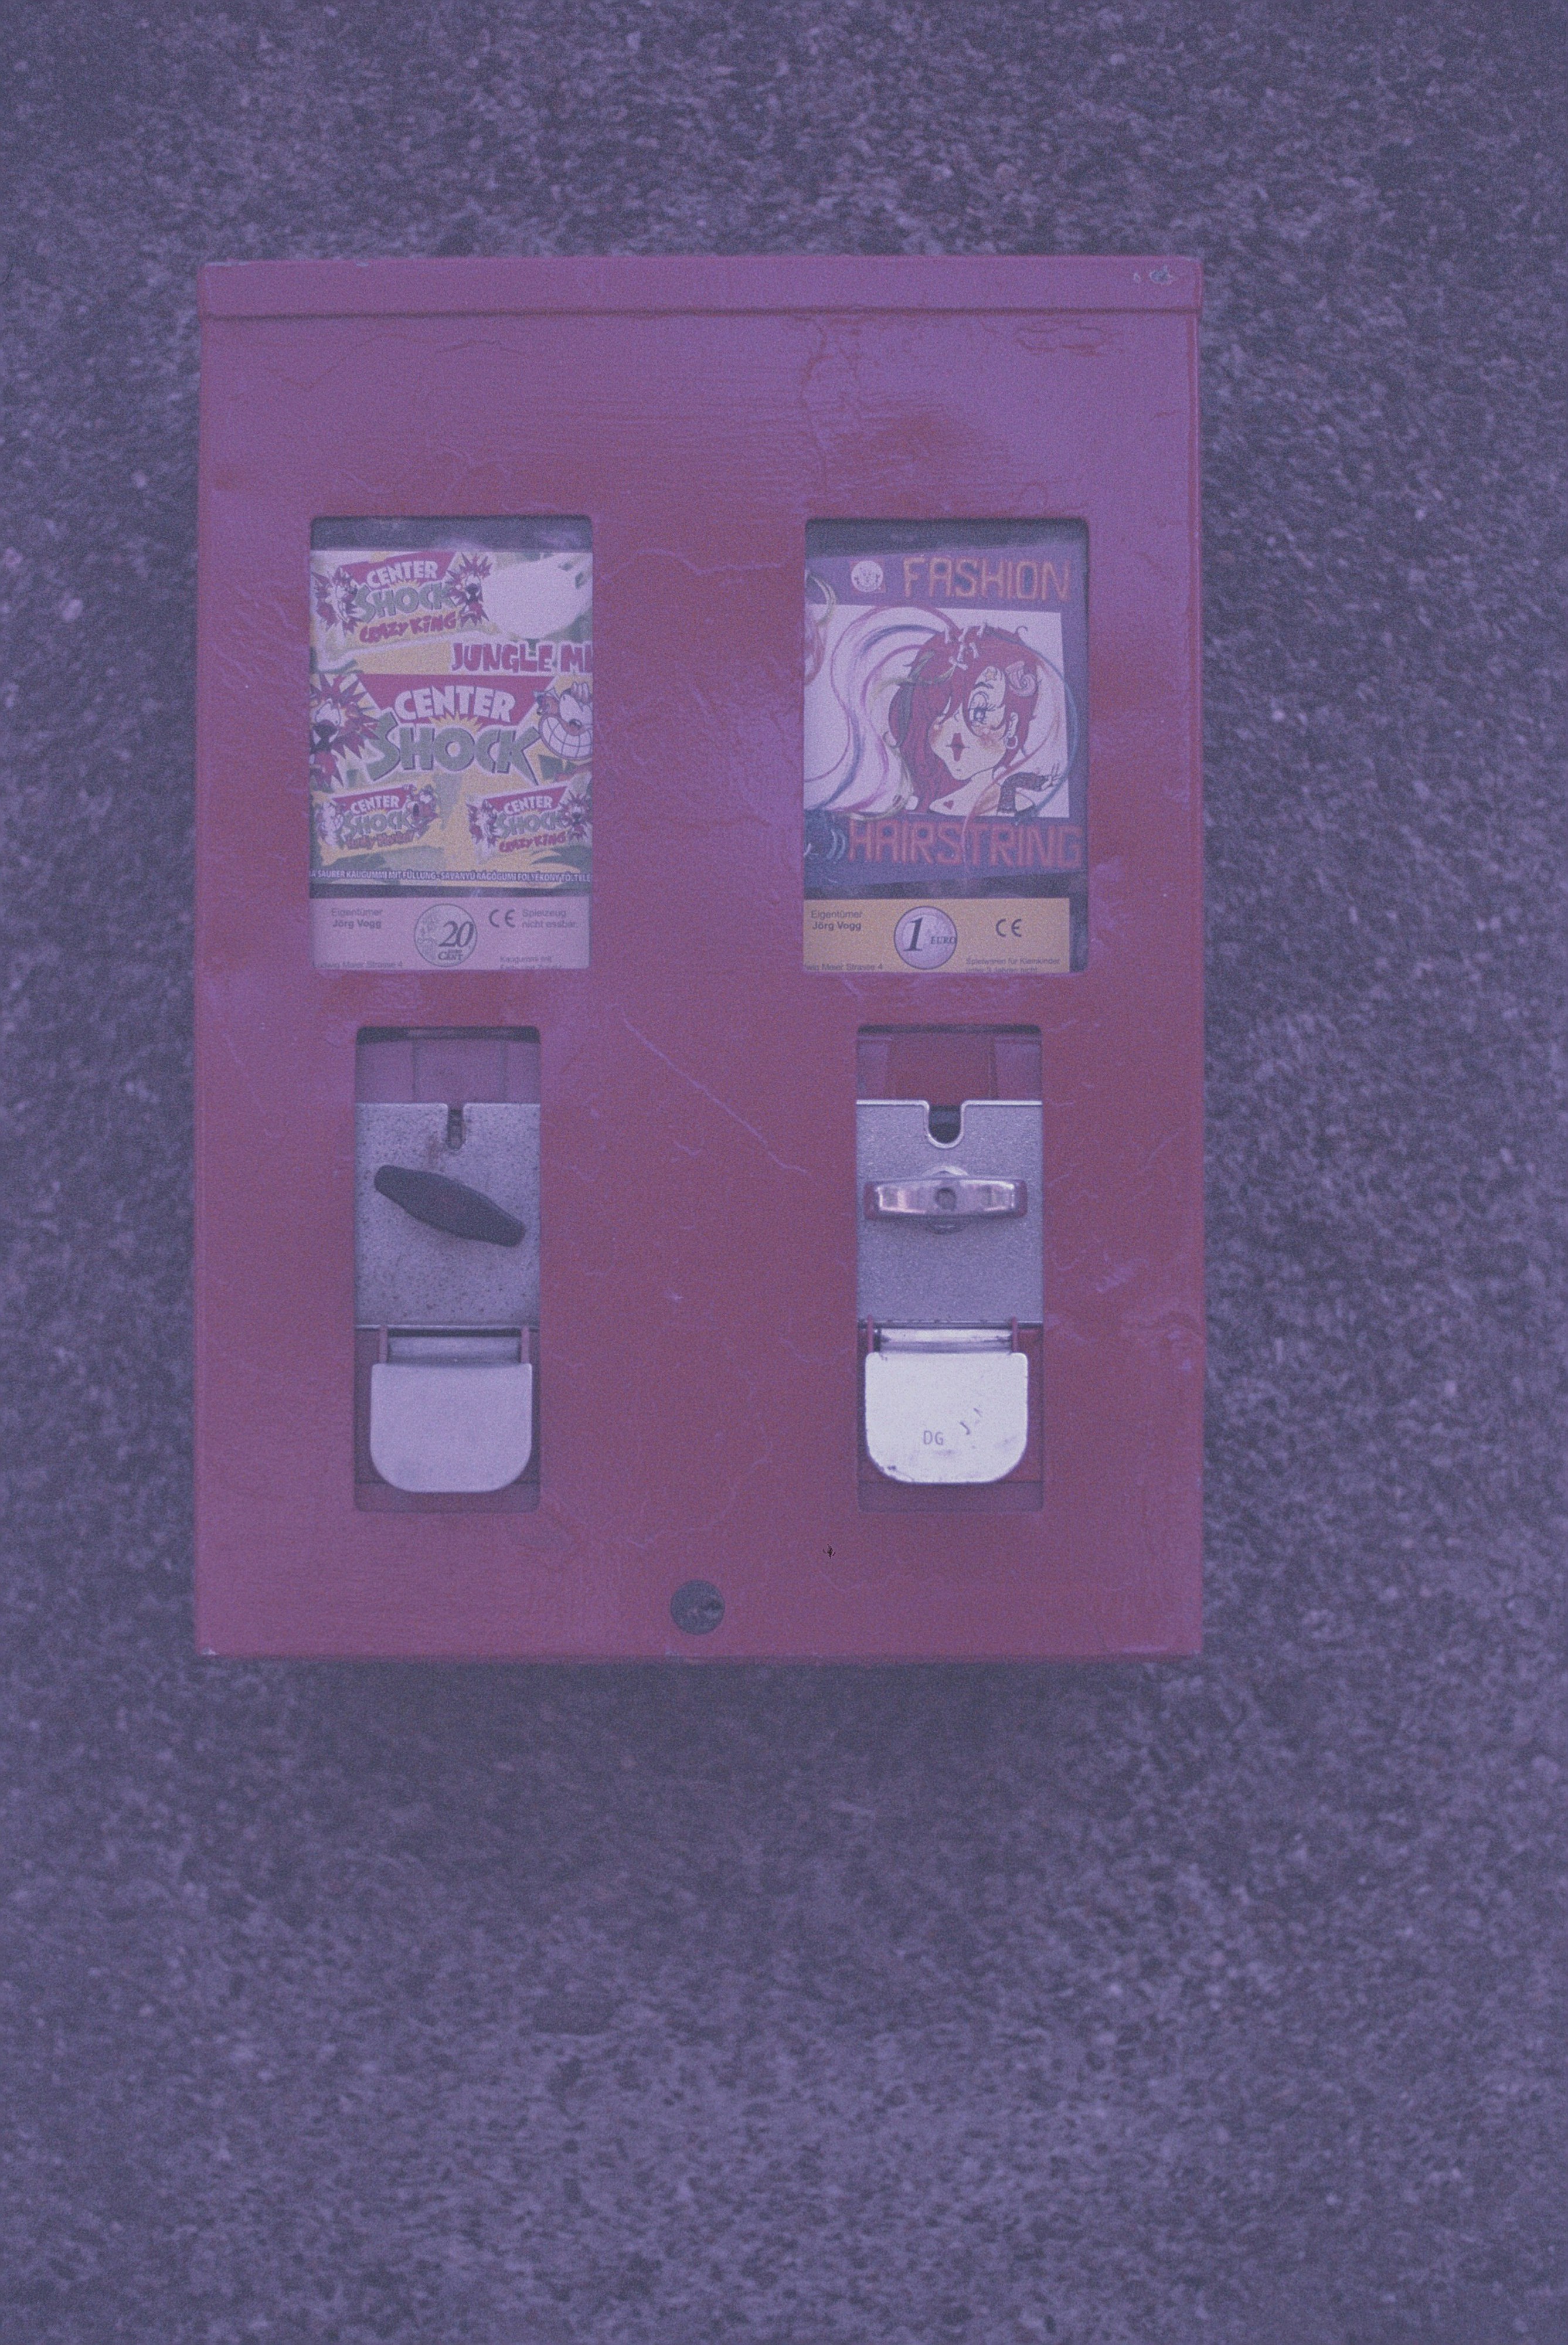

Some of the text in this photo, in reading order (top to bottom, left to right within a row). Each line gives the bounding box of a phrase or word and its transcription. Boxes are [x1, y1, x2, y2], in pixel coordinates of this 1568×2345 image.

[366, 560, 438, 589] CENTER
[902, 556, 1072, 601] FASHION
[353, 580, 461, 623] SHOCK
[359, 621, 409, 643] CRAZY
[451, 643, 553, 672] JUNGLE
[394, 685, 516, 723] CENTER
[365, 711, 543, 786] SHOCK
[351, 795, 400, 814] CENTER
[504, 796, 553, 815] CENTER
[342, 810, 414, 842] SHOCK
[494, 811, 570, 839] SHOCK
[847, 820, 1084, 869] HAIRSTRING
[318, 869, 346, 878] SAURER
[346, 870, 387, 879] KAUGUMMI
[388, 871, 402, 879] MIT
[402, 870, 436, 880] FÜLLUNG
[331, 908, 383, 917] Eigentümer
[522, 908, 567, 919] Spielzeug
[522, 919, 544, 927] nicht
[811, 910, 862, 920] Eigentümer
[332, 919, 382, 930] Jörg Vogg
[438, 920, 474, 947] 20
[812, 921, 862, 932] Jörg Vogg
[903, 917, 923, 951] 1
[930, 936, 957, 944] EURO
[923, 1429, 944, 1446] DG
